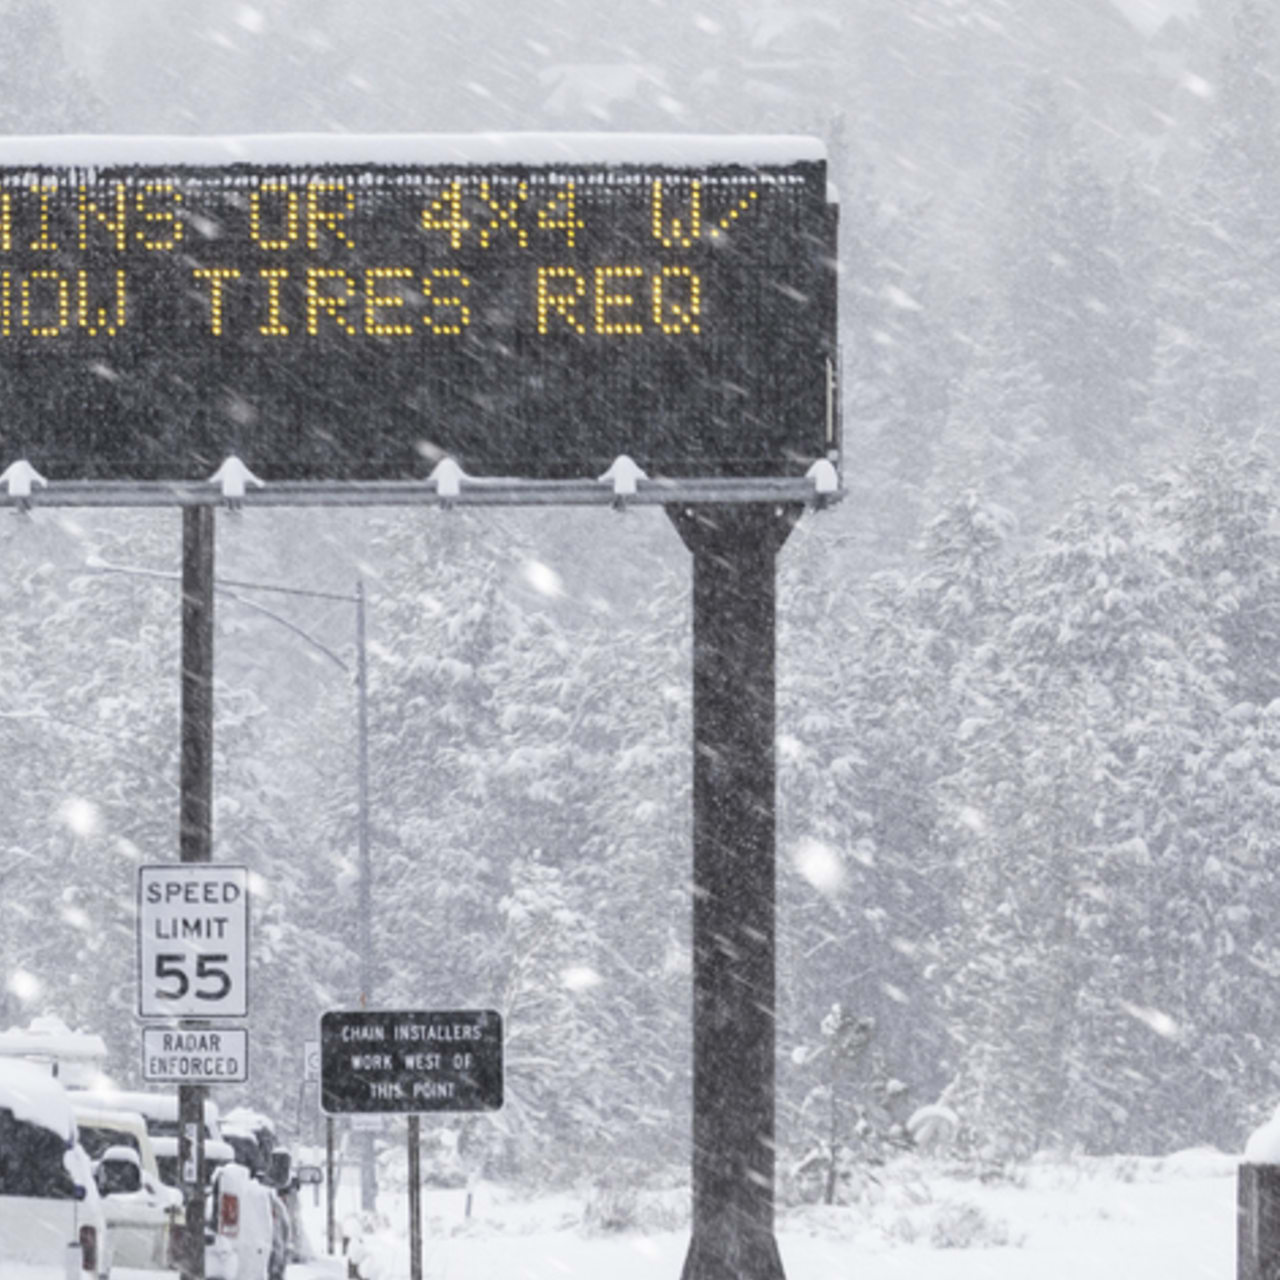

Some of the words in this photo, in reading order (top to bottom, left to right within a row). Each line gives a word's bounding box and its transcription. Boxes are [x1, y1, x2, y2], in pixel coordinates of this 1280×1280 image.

[249, 182, 355, 250] OR
[422, 180, 586, 249] 4X4
[651, 179, 758, 248] W/
[192, 268, 471, 336] TIRES
[537, 267, 701, 335] REQ
[146, 881, 241, 904] SPEED
[154, 917, 229, 940] LIMIT
[154, 953, 232, 1001] 55
[162, 1033, 221, 1052] RADAR
[341, 1024, 385, 1042] CHAIN
[393, 1023, 482, 1041] INSTALLERS
[149, 1056, 239, 1076] ENFORCED
[351, 1054, 393, 1070] WORK
[404, 1053, 441, 1070] WEST
[452, 1052, 473, 1069] OF
[370, 1081, 403, 1099] THIS
[412, 1081, 456, 1098] POINT
